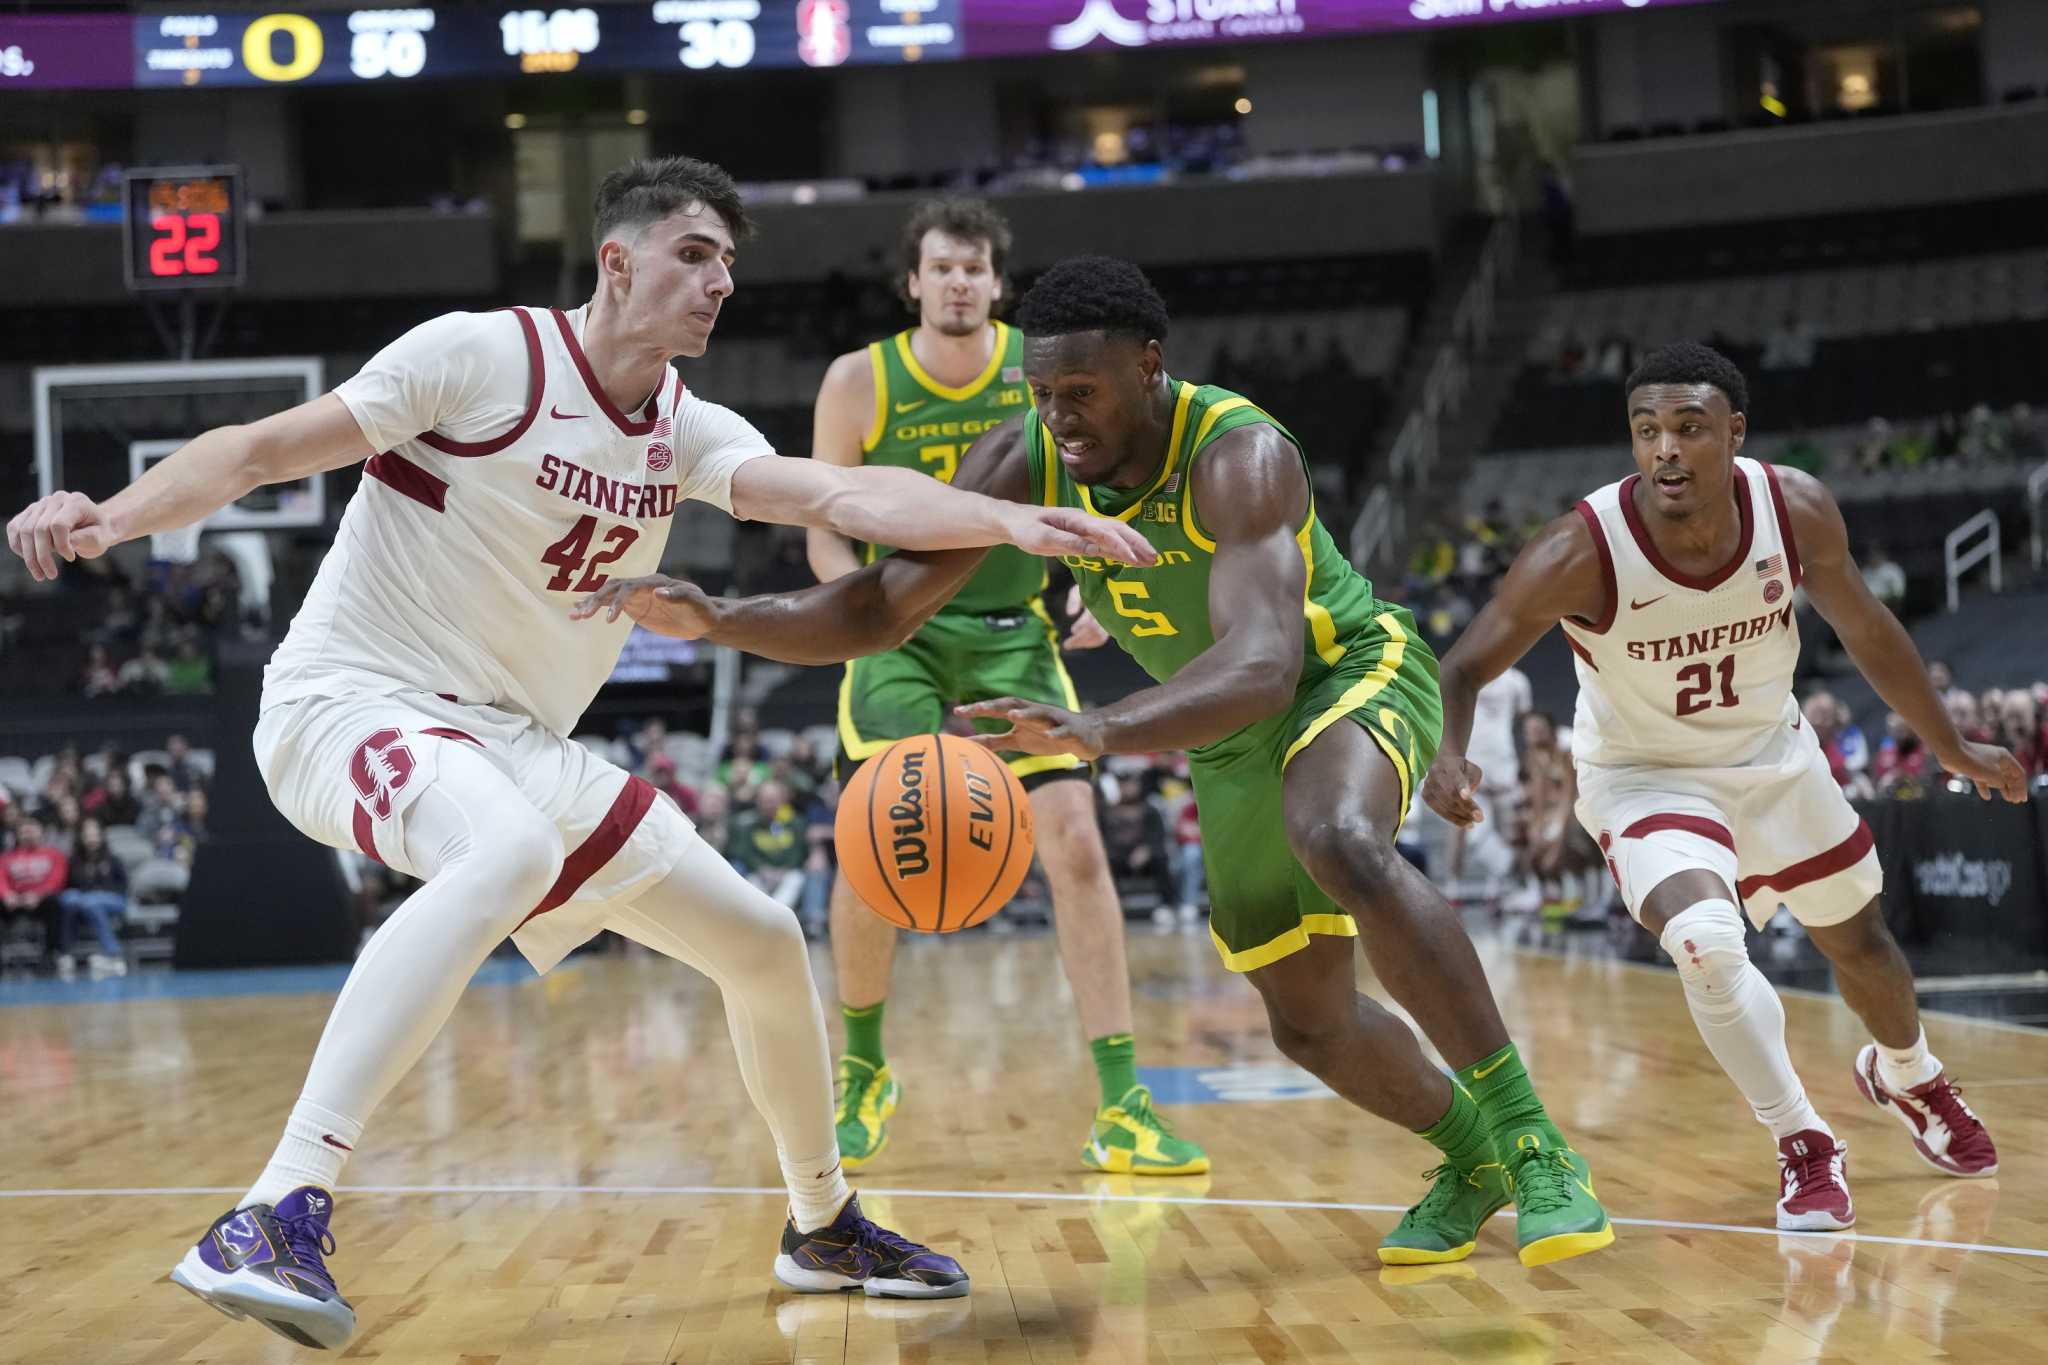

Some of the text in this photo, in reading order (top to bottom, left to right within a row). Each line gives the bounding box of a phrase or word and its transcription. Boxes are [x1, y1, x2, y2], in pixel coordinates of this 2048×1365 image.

[242, 13, 324, 82] O
[679, 20, 755, 69] 30
[150, 213, 221, 276] 22
[896, 419, 1003, 441] OREG
[536, 453, 678, 518] STANFRD
[540, 514, 639, 593] 42
[1107, 576, 1179, 637] 5
[1676, 654, 1740, 717] 21
[889, 751, 929, 881] Wilson
